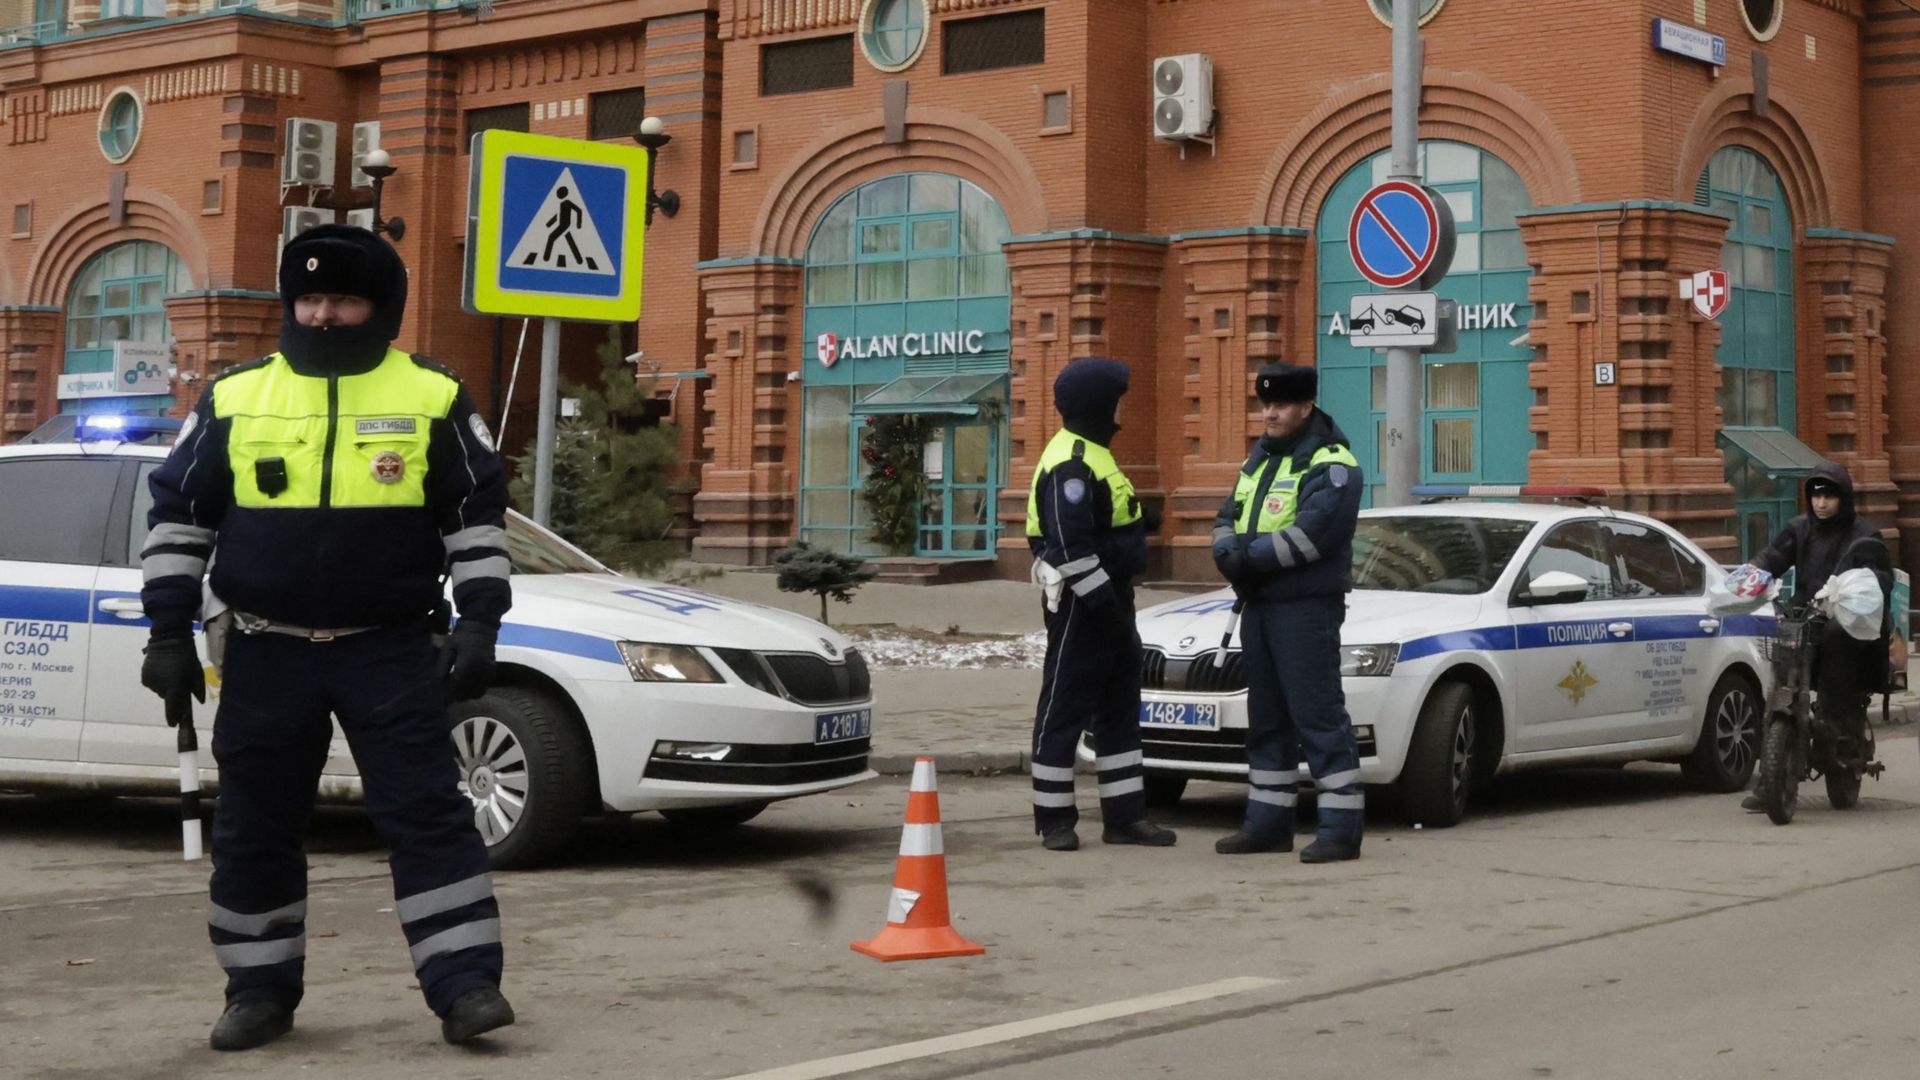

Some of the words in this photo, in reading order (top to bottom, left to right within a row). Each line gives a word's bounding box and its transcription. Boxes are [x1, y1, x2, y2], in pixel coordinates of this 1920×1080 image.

[840, 333, 897, 359] ALAN
[902, 329, 984, 357] CLINIC
[359, 421, 379, 431] ДПС
[381, 420, 413, 430] ГИБДД
[4, 621, 69, 641] ГИБДД
[1547, 622, 1609, 644] ПОЛИЦИЯ
[4, 641, 50, 656] СЗАО
[32, 662, 74, 673] Москве
[19, 705, 56, 716] ЧАСТИ
[1145, 702, 1186, 724] 1482
[1196, 704, 1214, 721] 99
[831, 712, 858, 739] 2187
[861, 710, 869, 727] 99
